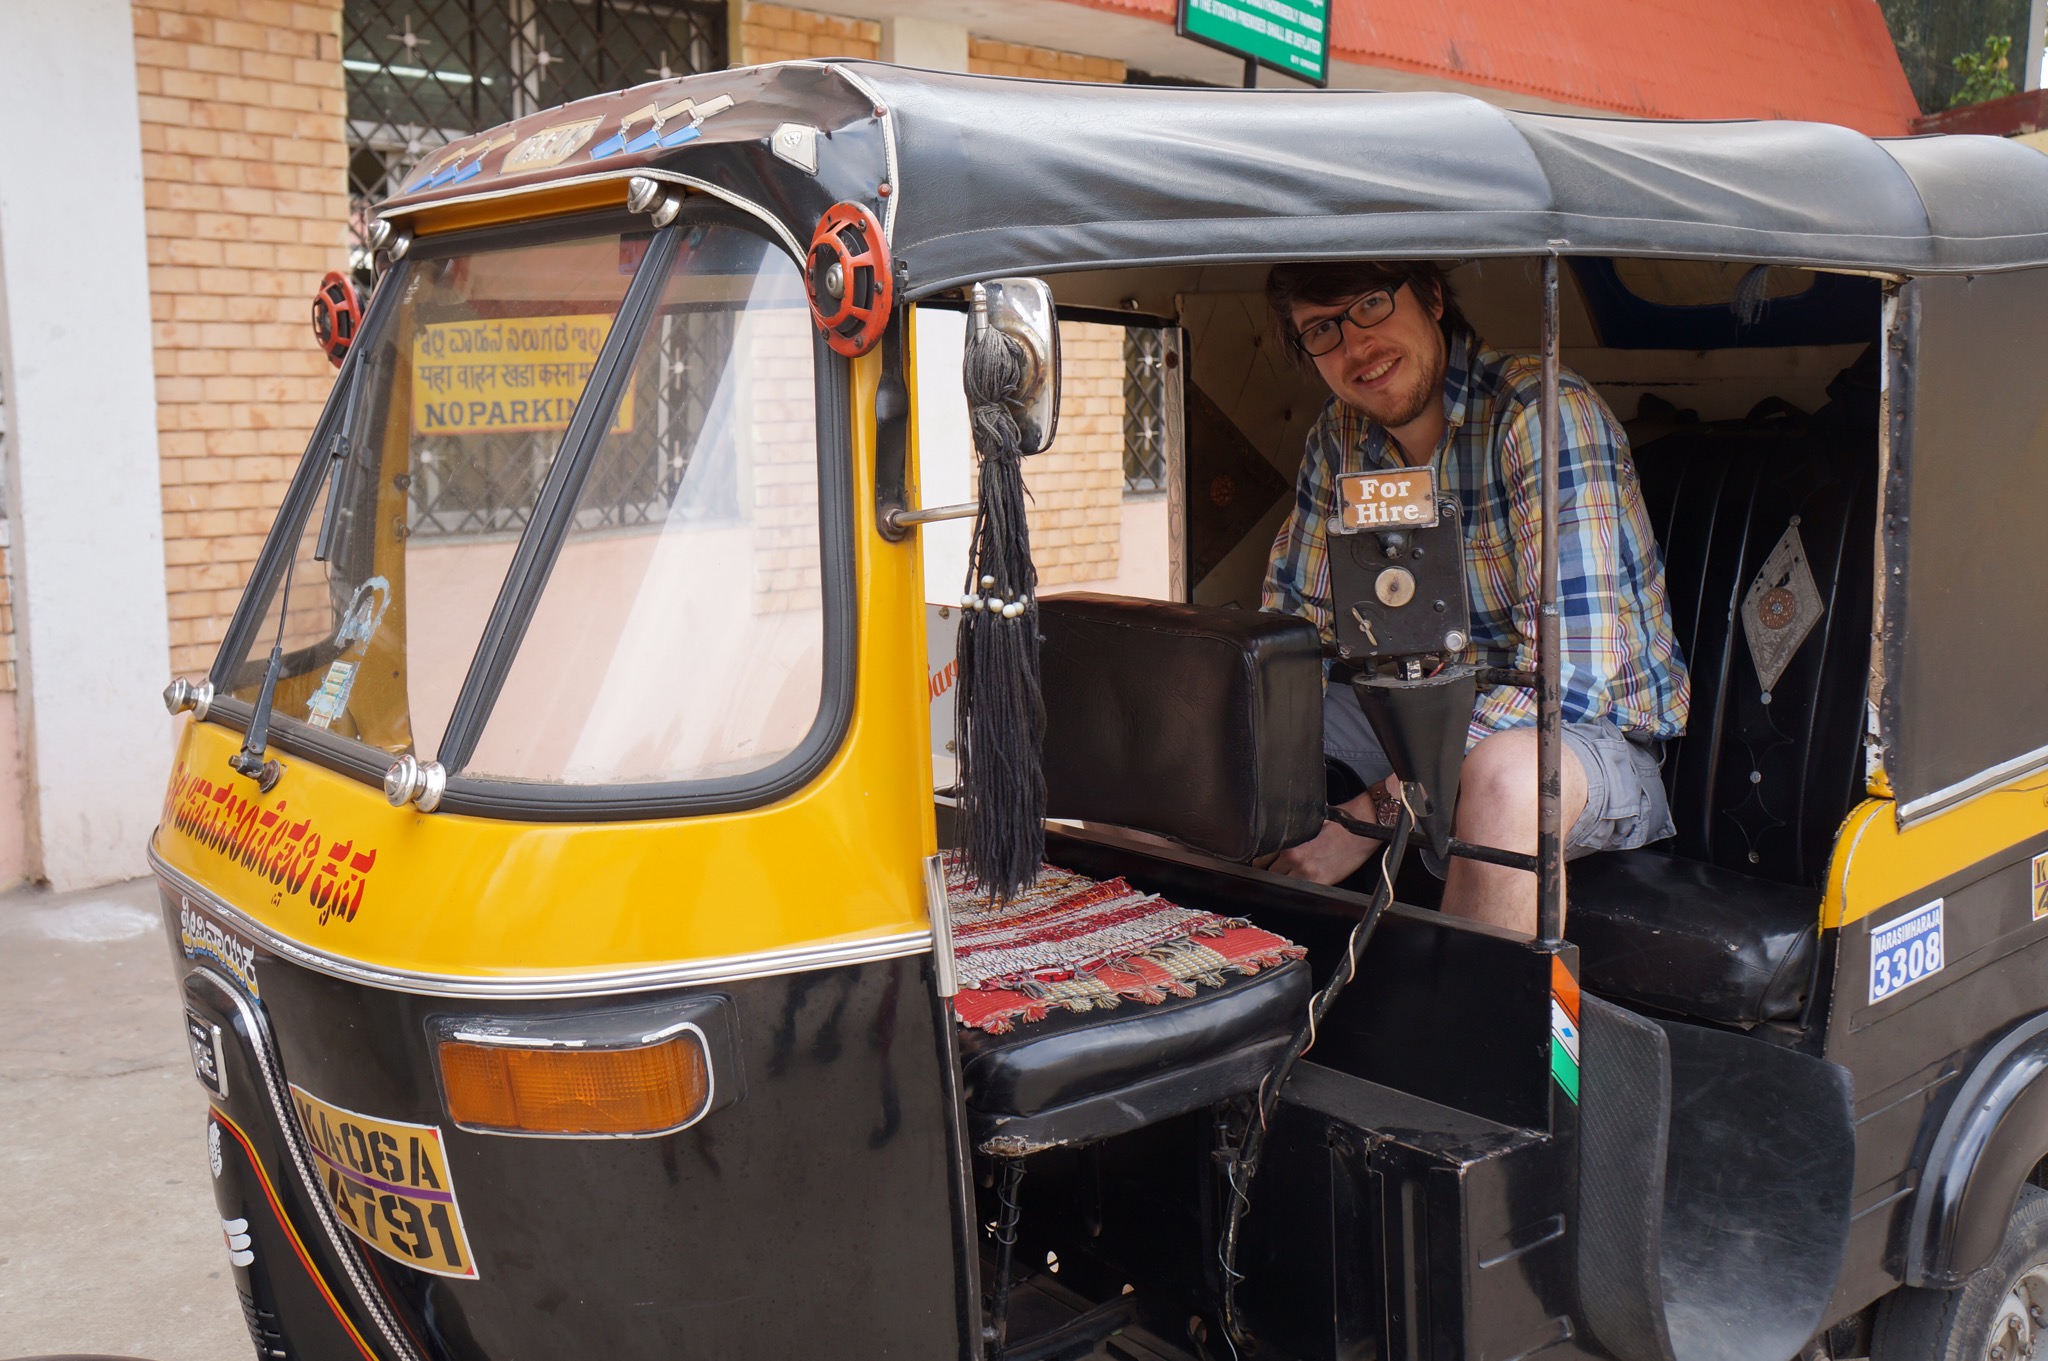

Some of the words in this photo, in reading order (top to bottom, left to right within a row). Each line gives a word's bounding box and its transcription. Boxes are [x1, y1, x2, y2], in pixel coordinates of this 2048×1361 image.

[449, 323, 503, 353] ವಾಹನ
[457, 364, 497, 394] वाहन
[1360, 479, 1411, 500] For
[1355, 501, 1420, 524] Hire
[1875, 909, 1940, 956] NARASIMHARAJA
[1874, 931, 1940, 997] 3308
[329, 1168, 463, 1268] 4791
